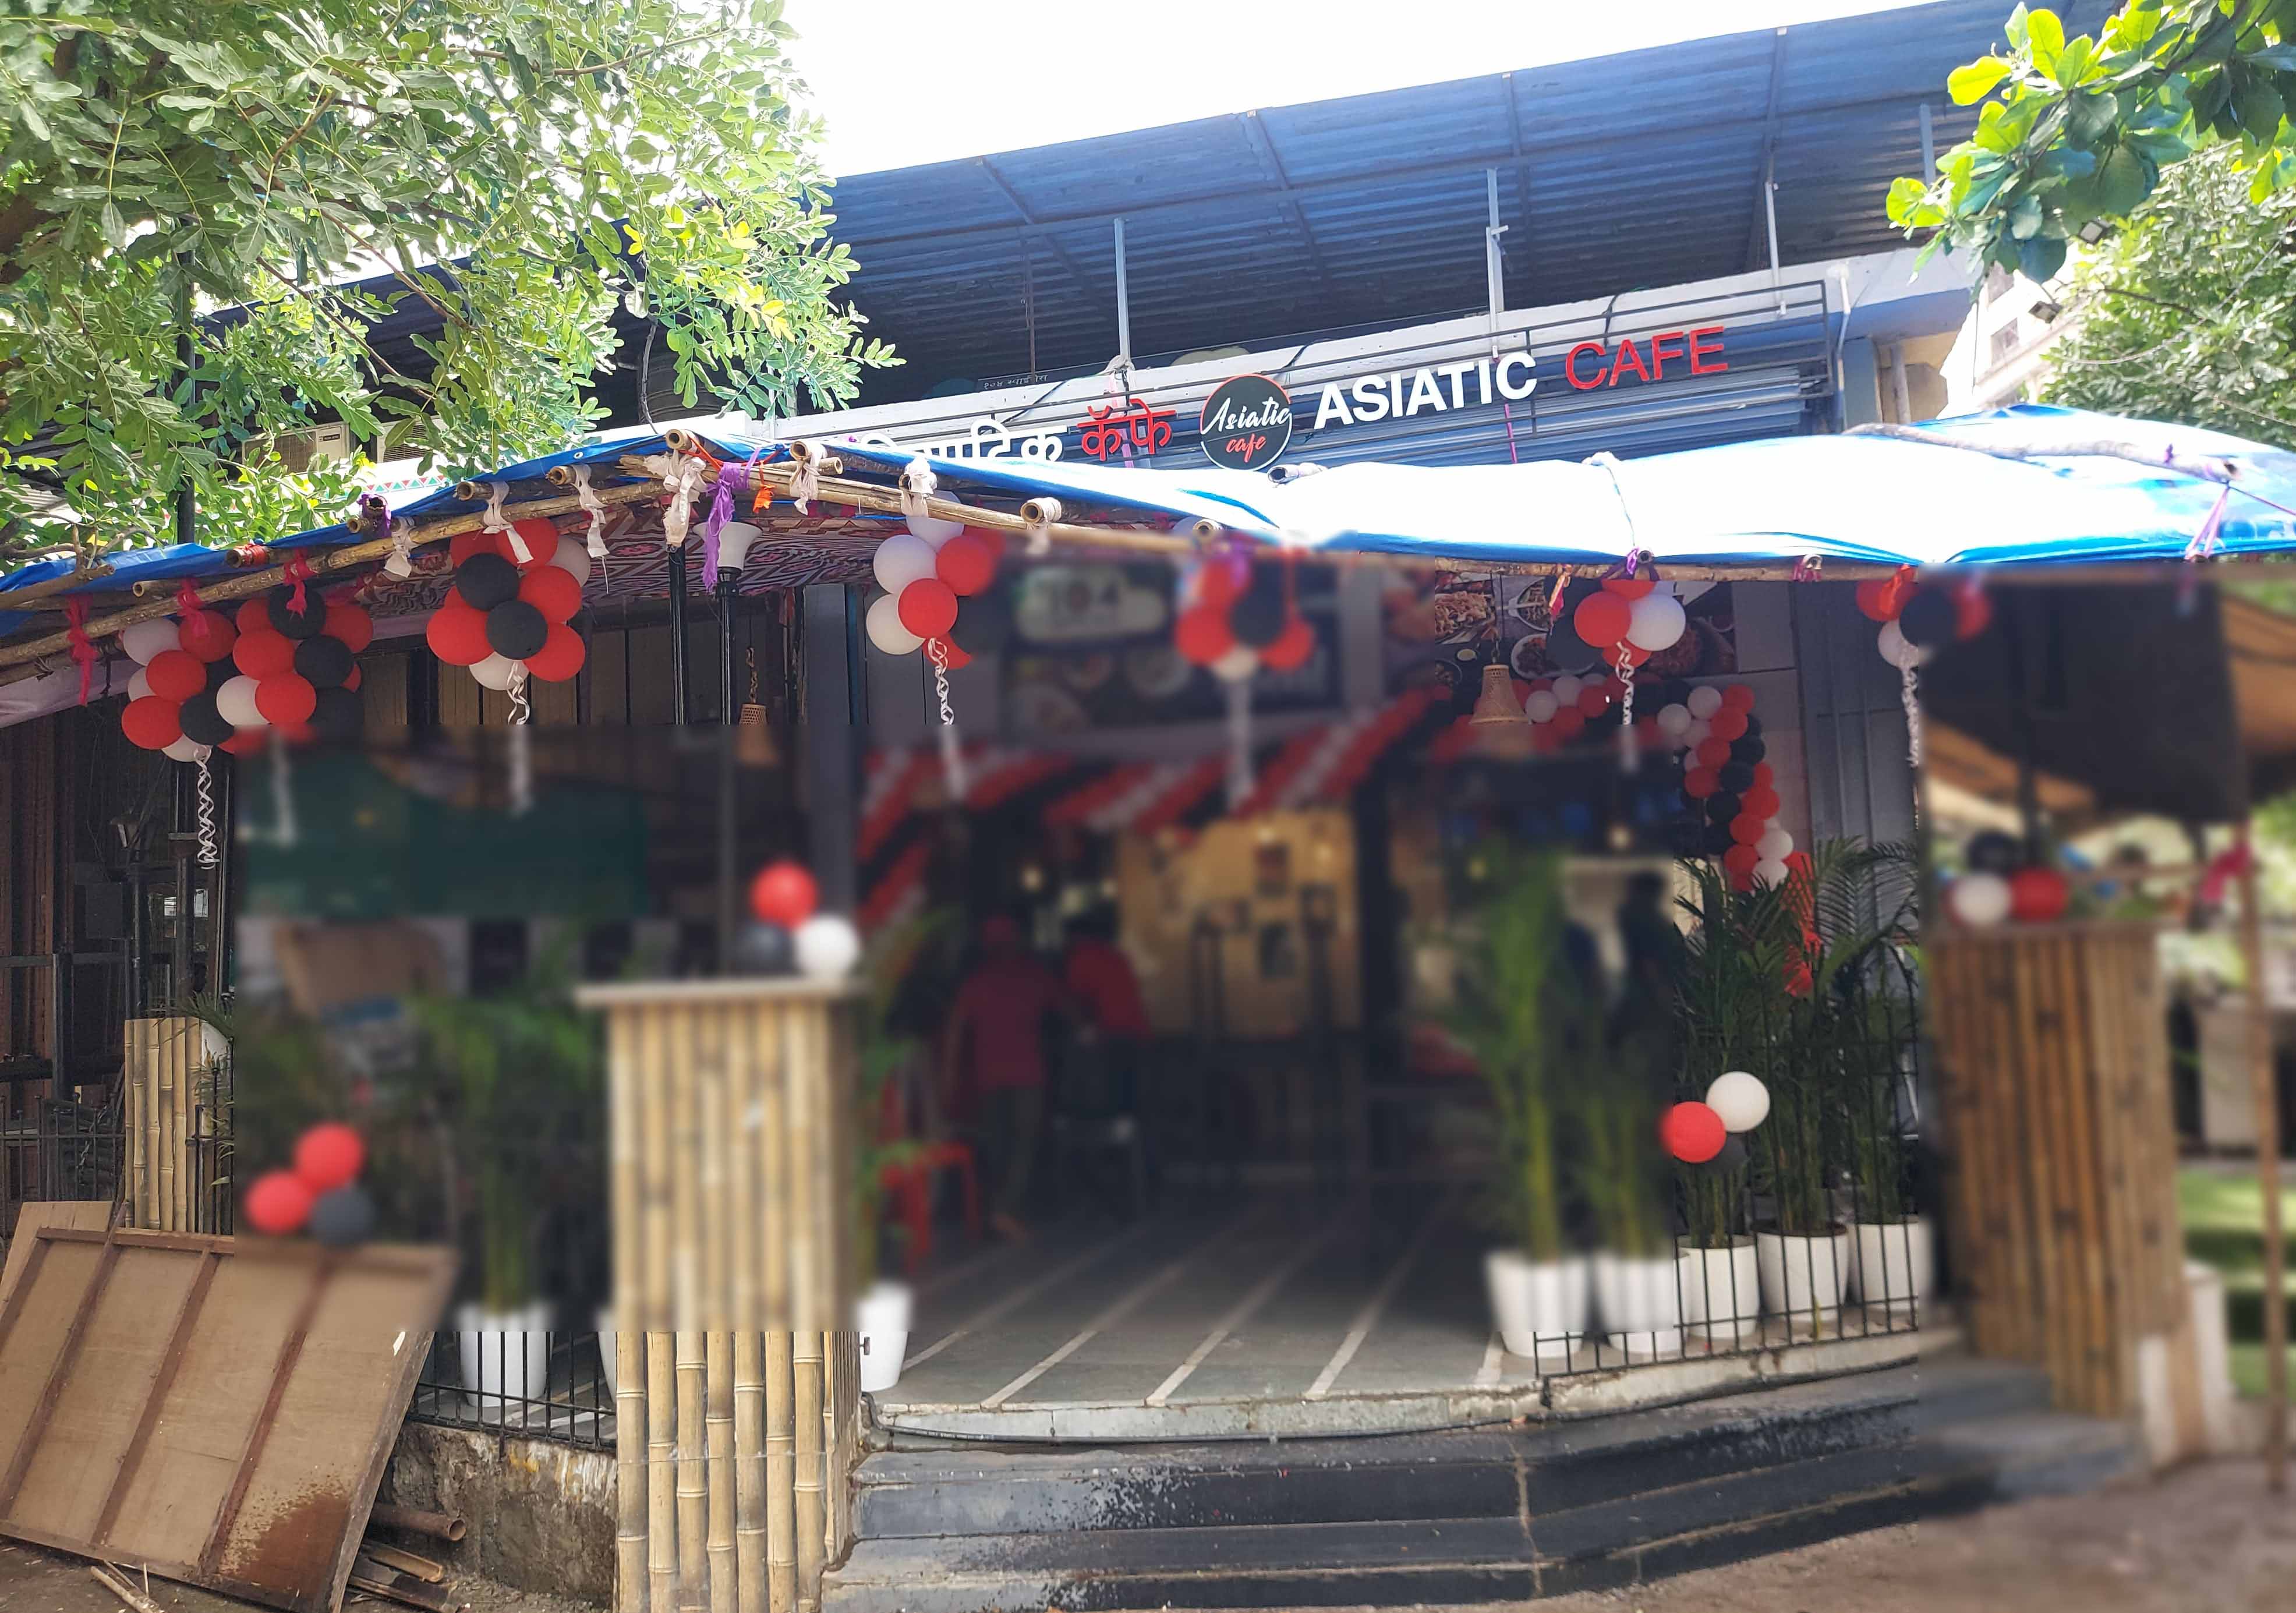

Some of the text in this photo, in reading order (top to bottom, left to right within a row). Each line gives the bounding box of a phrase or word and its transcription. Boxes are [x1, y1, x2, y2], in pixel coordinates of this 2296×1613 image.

[1314, 326, 1729, 430] ASIATIC CAFE
[1201, 396, 1291, 435] Asiatic
[1226, 433, 1266, 464] cafe
